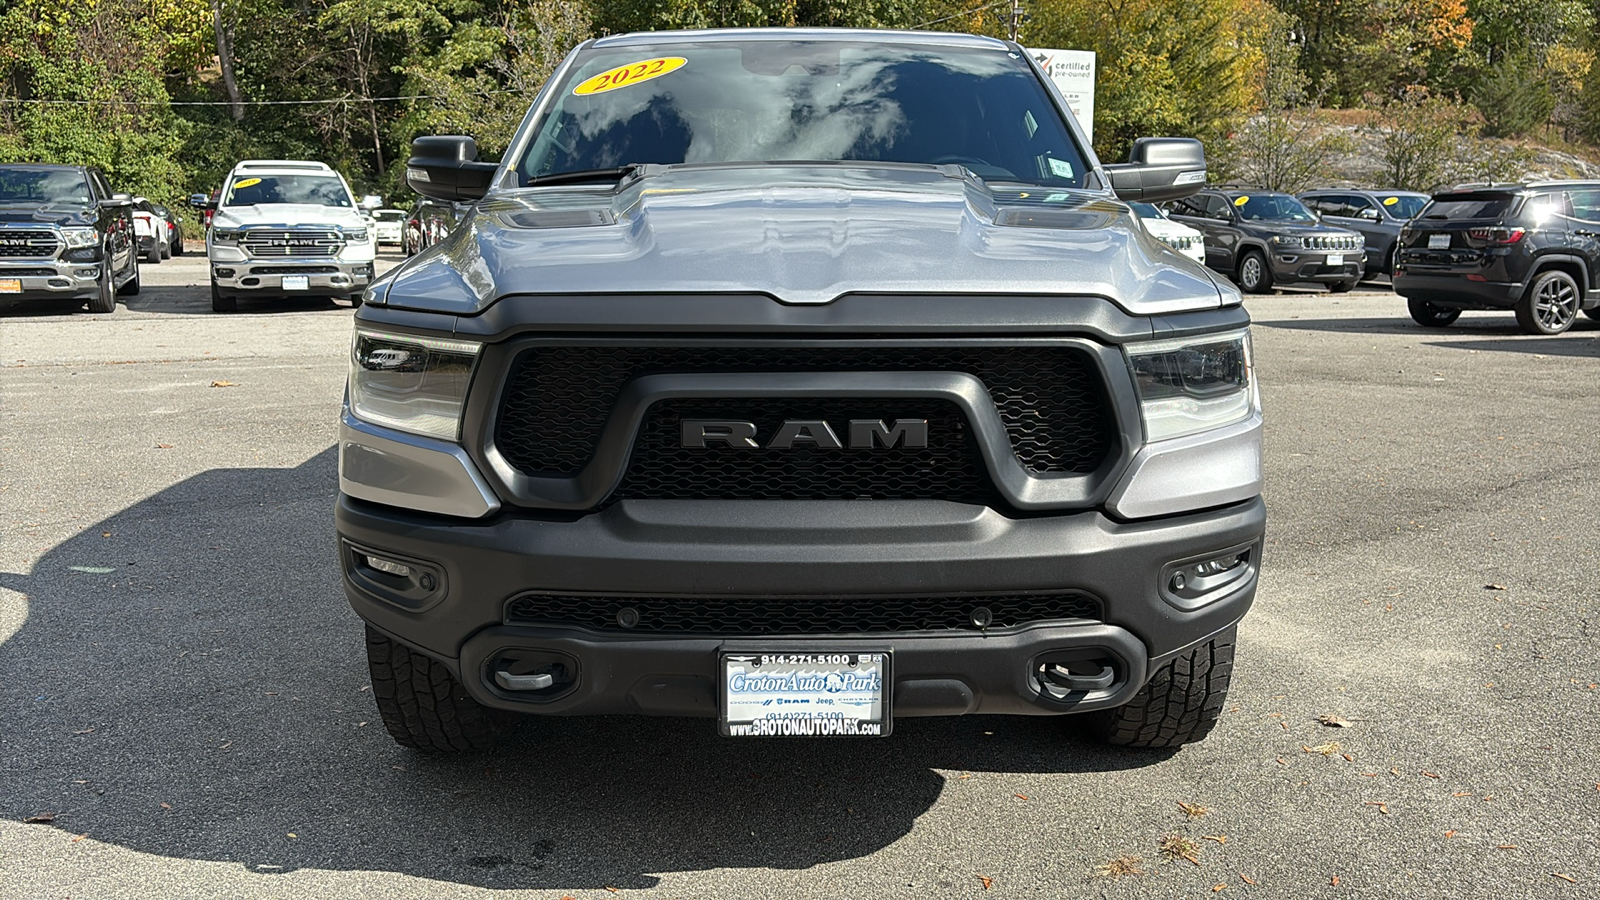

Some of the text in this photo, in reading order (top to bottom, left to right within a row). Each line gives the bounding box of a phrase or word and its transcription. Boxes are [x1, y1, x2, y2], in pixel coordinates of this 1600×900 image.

[1055, 62, 1090, 71] certified
[592, 60, 666, 92] 2022
[1055, 70, 1090, 78] pre-owned
[680, 418, 929, 449] RAM
[841, 672, 881, 692] Park
[815, 697, 834, 706] Jeep
